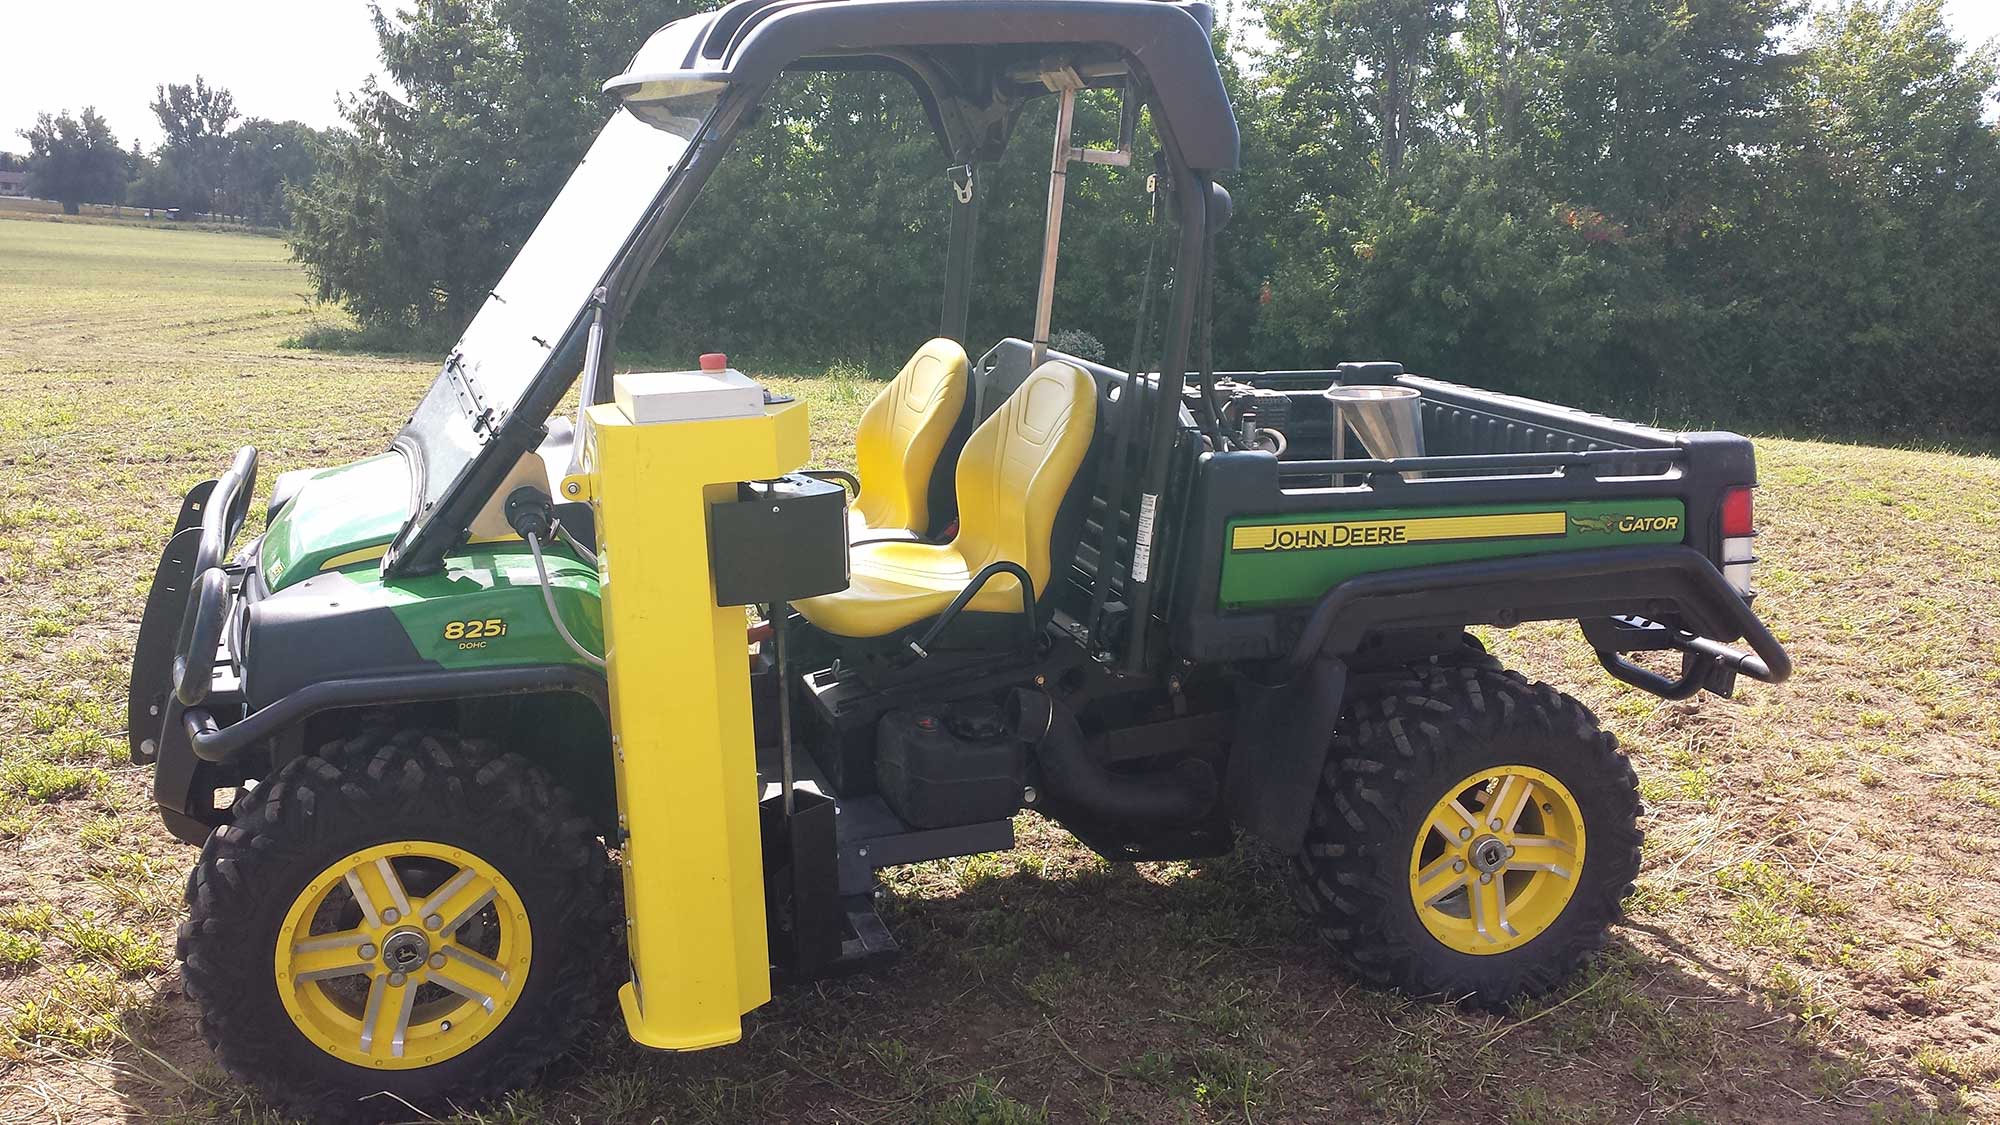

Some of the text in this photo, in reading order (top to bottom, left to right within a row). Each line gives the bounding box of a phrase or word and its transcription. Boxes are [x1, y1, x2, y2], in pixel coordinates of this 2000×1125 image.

[1618, 515, 1679, 533] GATOR
[1263, 525, 1406, 548] JOHN DEERE
[443, 618, 507, 640] 825i
[458, 641, 487, 650] DOHC
